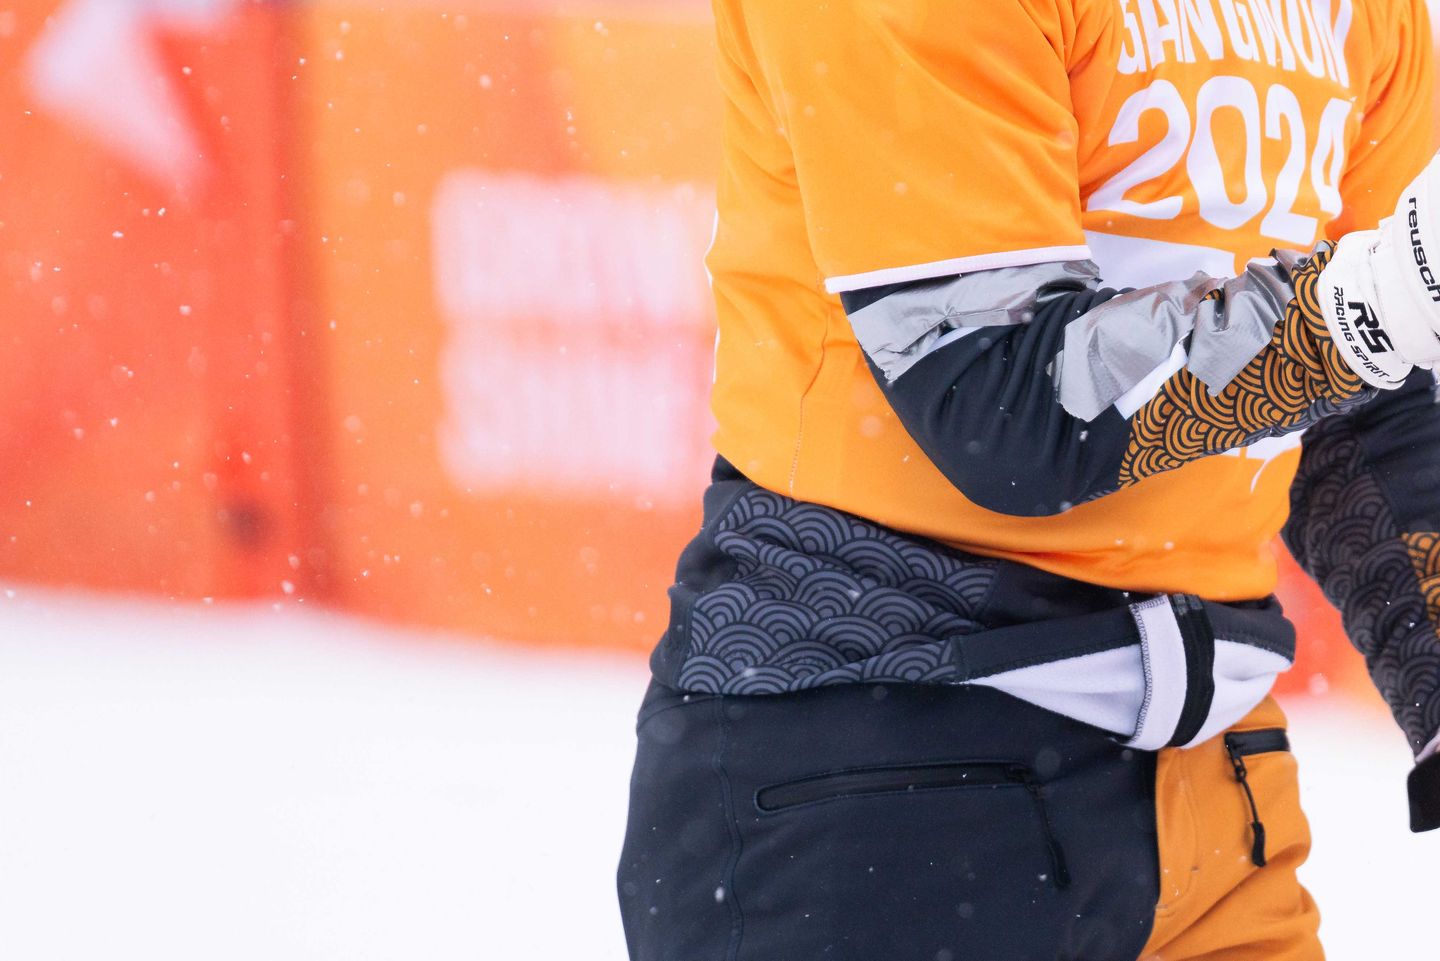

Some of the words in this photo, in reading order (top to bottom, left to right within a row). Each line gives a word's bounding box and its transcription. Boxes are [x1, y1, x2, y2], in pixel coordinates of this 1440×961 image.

[1333, 286, 1355, 342] RACING
[1350, 344, 1390, 377] SPIRIT
[1347, 301, 1395, 354] RS
